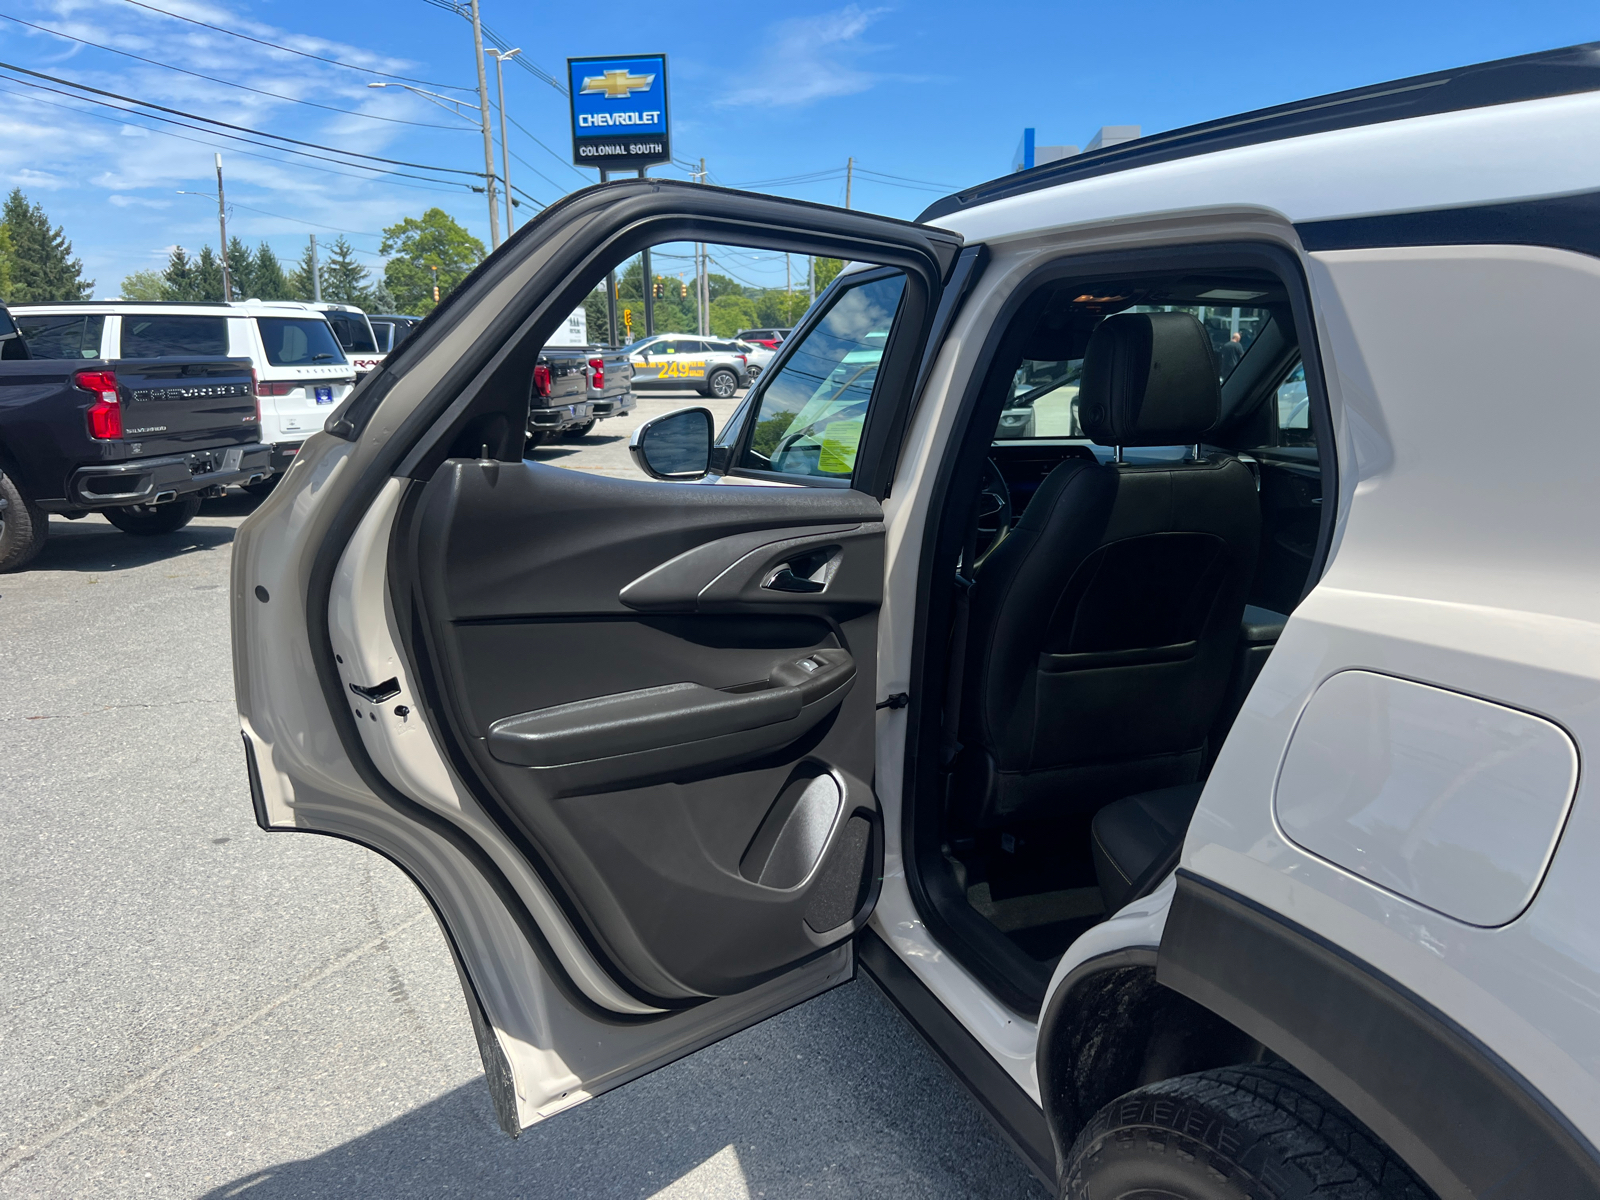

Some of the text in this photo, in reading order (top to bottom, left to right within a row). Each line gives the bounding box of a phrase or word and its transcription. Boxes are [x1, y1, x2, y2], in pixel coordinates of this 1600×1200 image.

[579, 111, 660, 127] CHEVROLET
[580, 143, 662, 156] COLONIAL SOUTH
